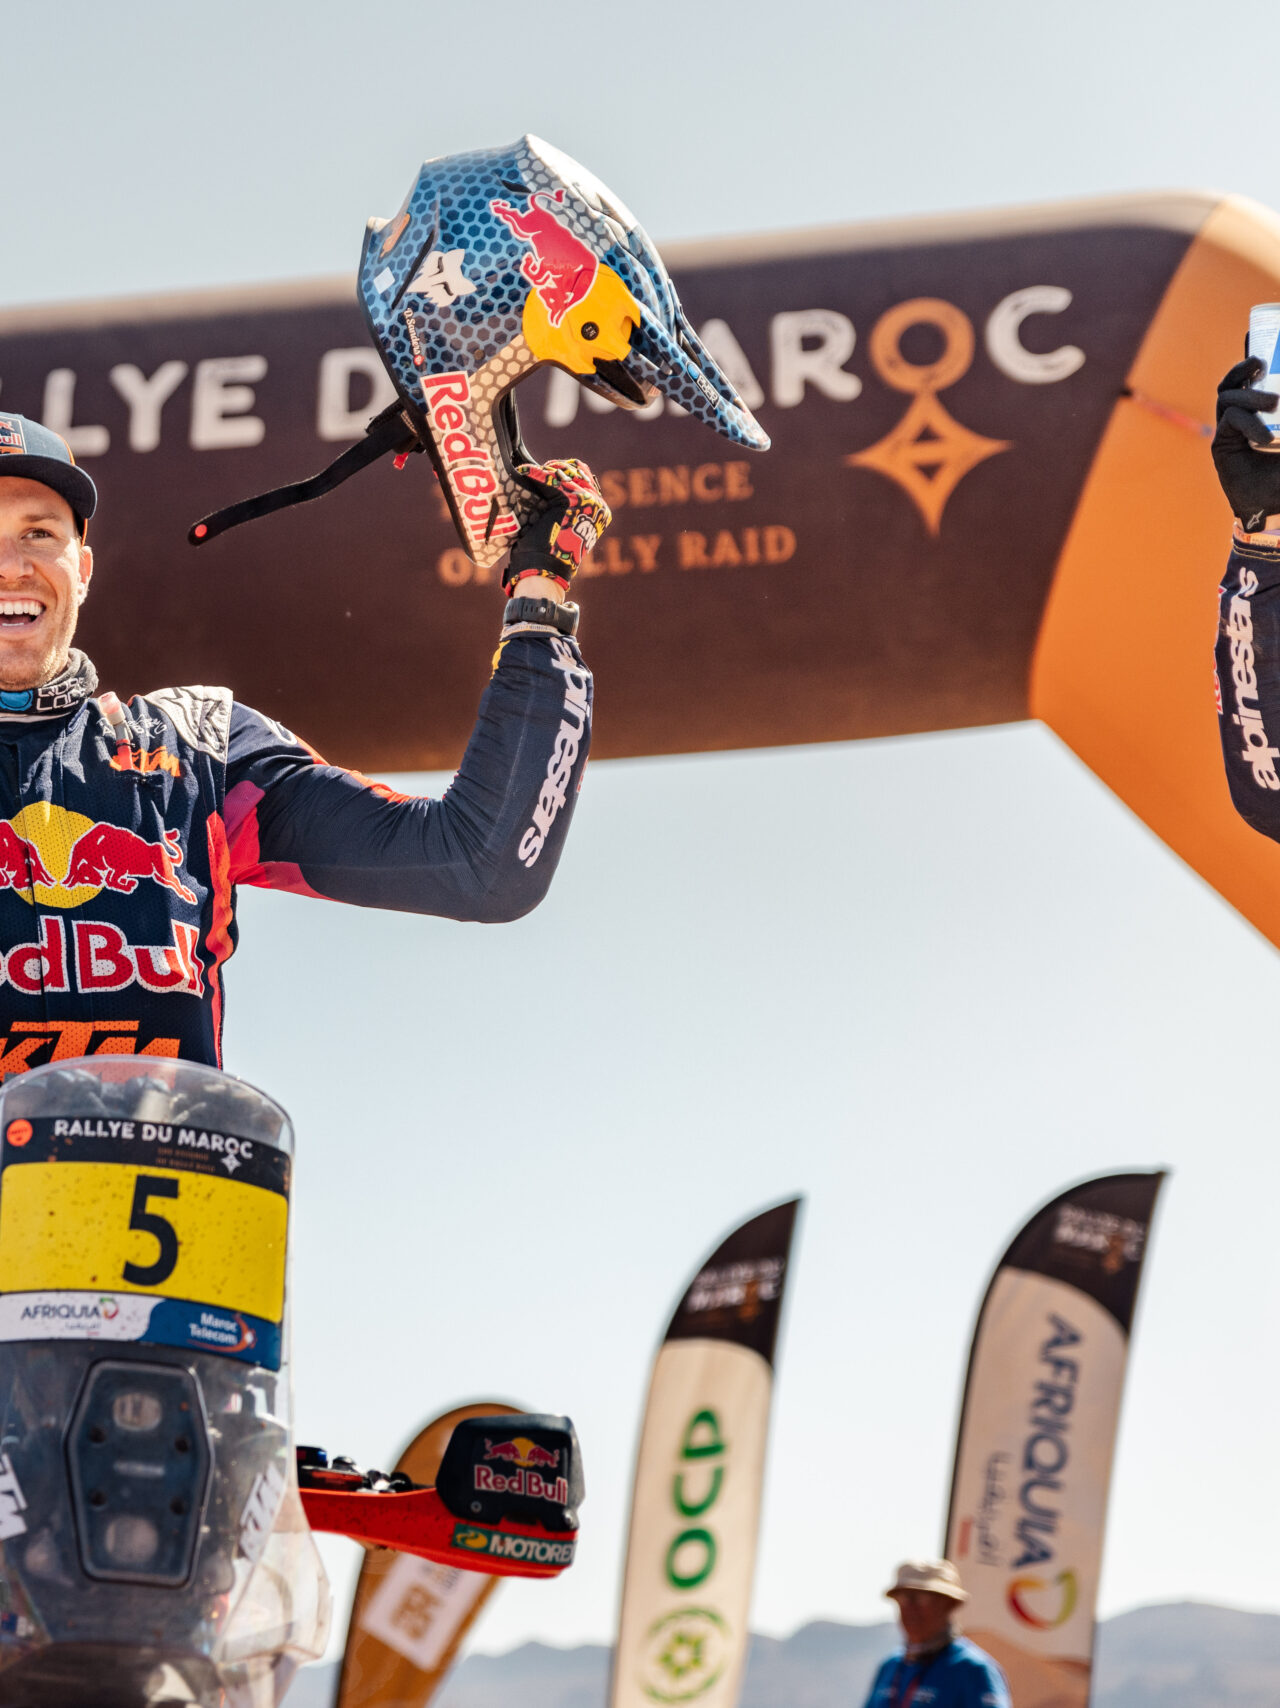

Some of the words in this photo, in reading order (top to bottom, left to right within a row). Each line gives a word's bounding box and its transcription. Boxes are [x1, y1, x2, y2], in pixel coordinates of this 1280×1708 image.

[420, 371, 491, 467] Red
[450, 464, 521, 543] Bull
[602, 460, 754, 509] SENCE
[678, 525, 798, 571] RAID
[71, 918, 206, 999] Bull
[54, 1119, 135, 1140] RALLYE
[141, 1123, 173, 1143] DU
[177, 1128, 253, 1160] MAROC
[122, 1174, 180, 1286] 5
[21, 1304, 100, 1320] AFRIQUIA
[188, 1323, 238, 1346] Telecom
[200, 1312, 238, 1332] Maroc
[1012, 1312, 1084, 1570] AFRIQUIA
[474, 1464, 525, 1494] Red
[526, 1472, 568, 1505] Bull
